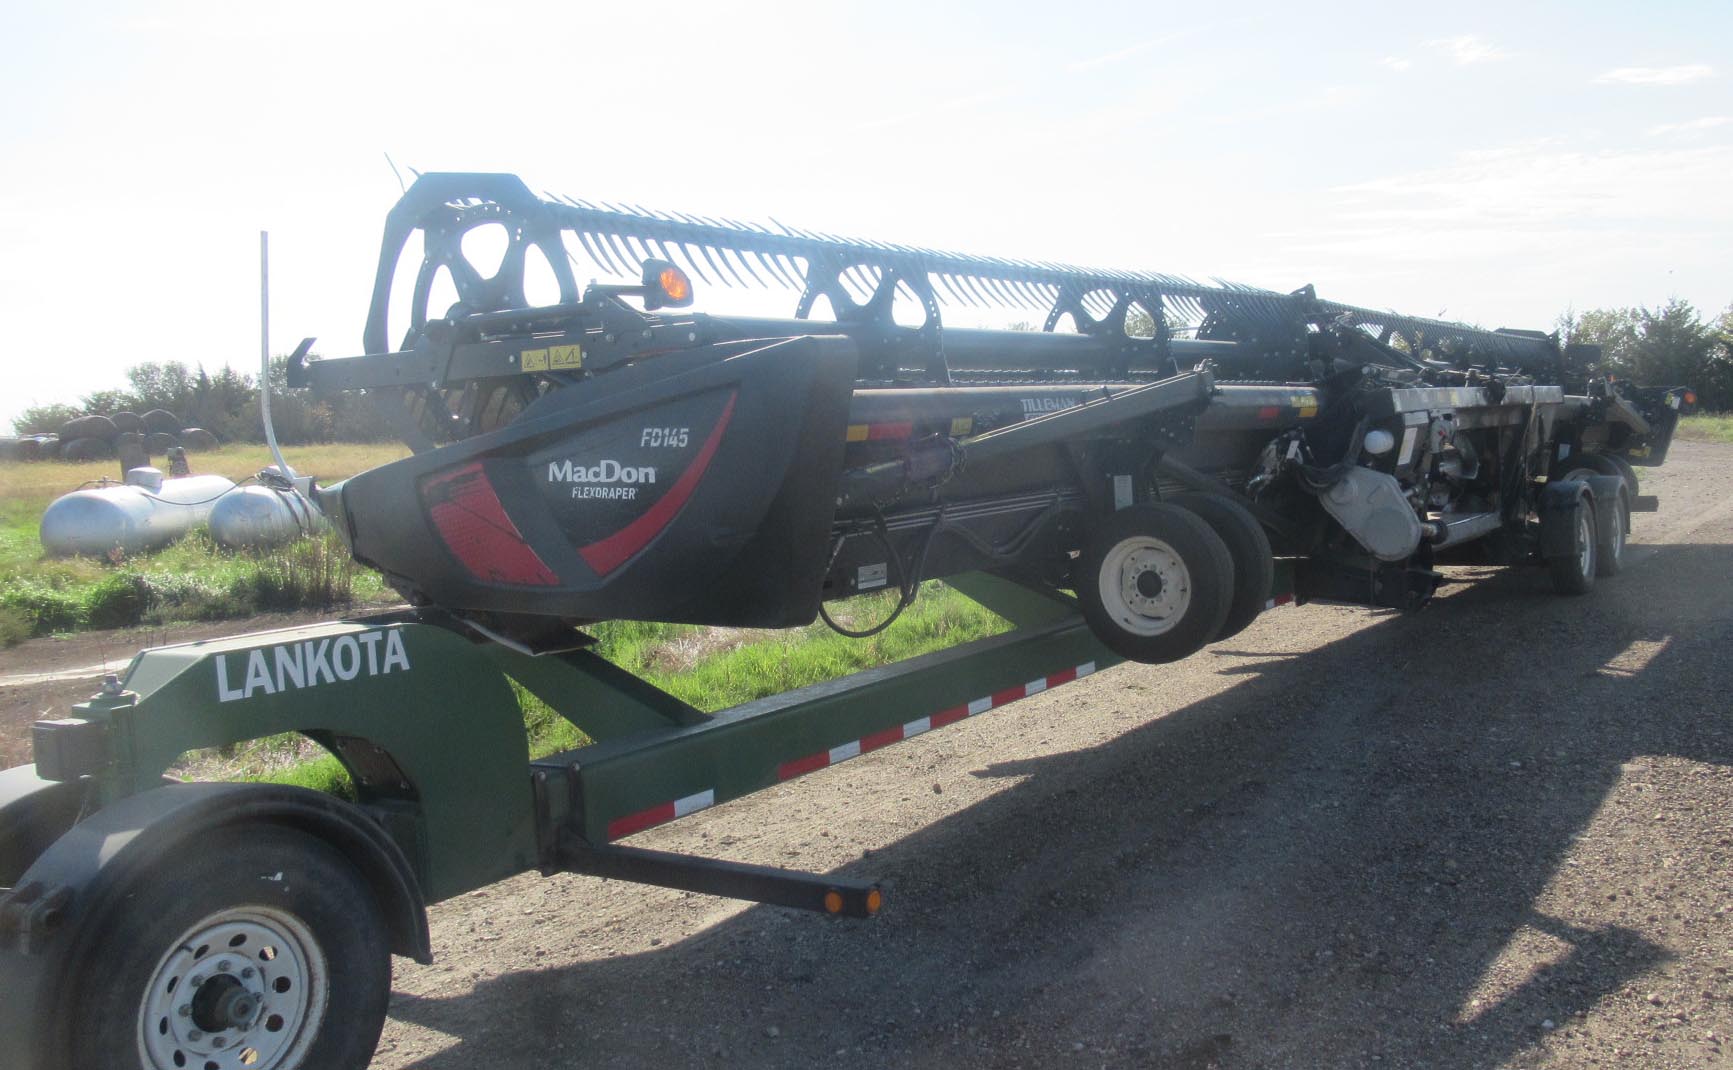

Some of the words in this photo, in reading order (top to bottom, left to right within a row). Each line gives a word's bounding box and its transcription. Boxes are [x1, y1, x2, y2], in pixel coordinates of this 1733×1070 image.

[641, 428, 689, 447] FD145
[548, 459, 656, 483] MacDon
[572, 487, 637, 500] FLEXDRAPER
[215, 629, 410, 702] LANKOTA
